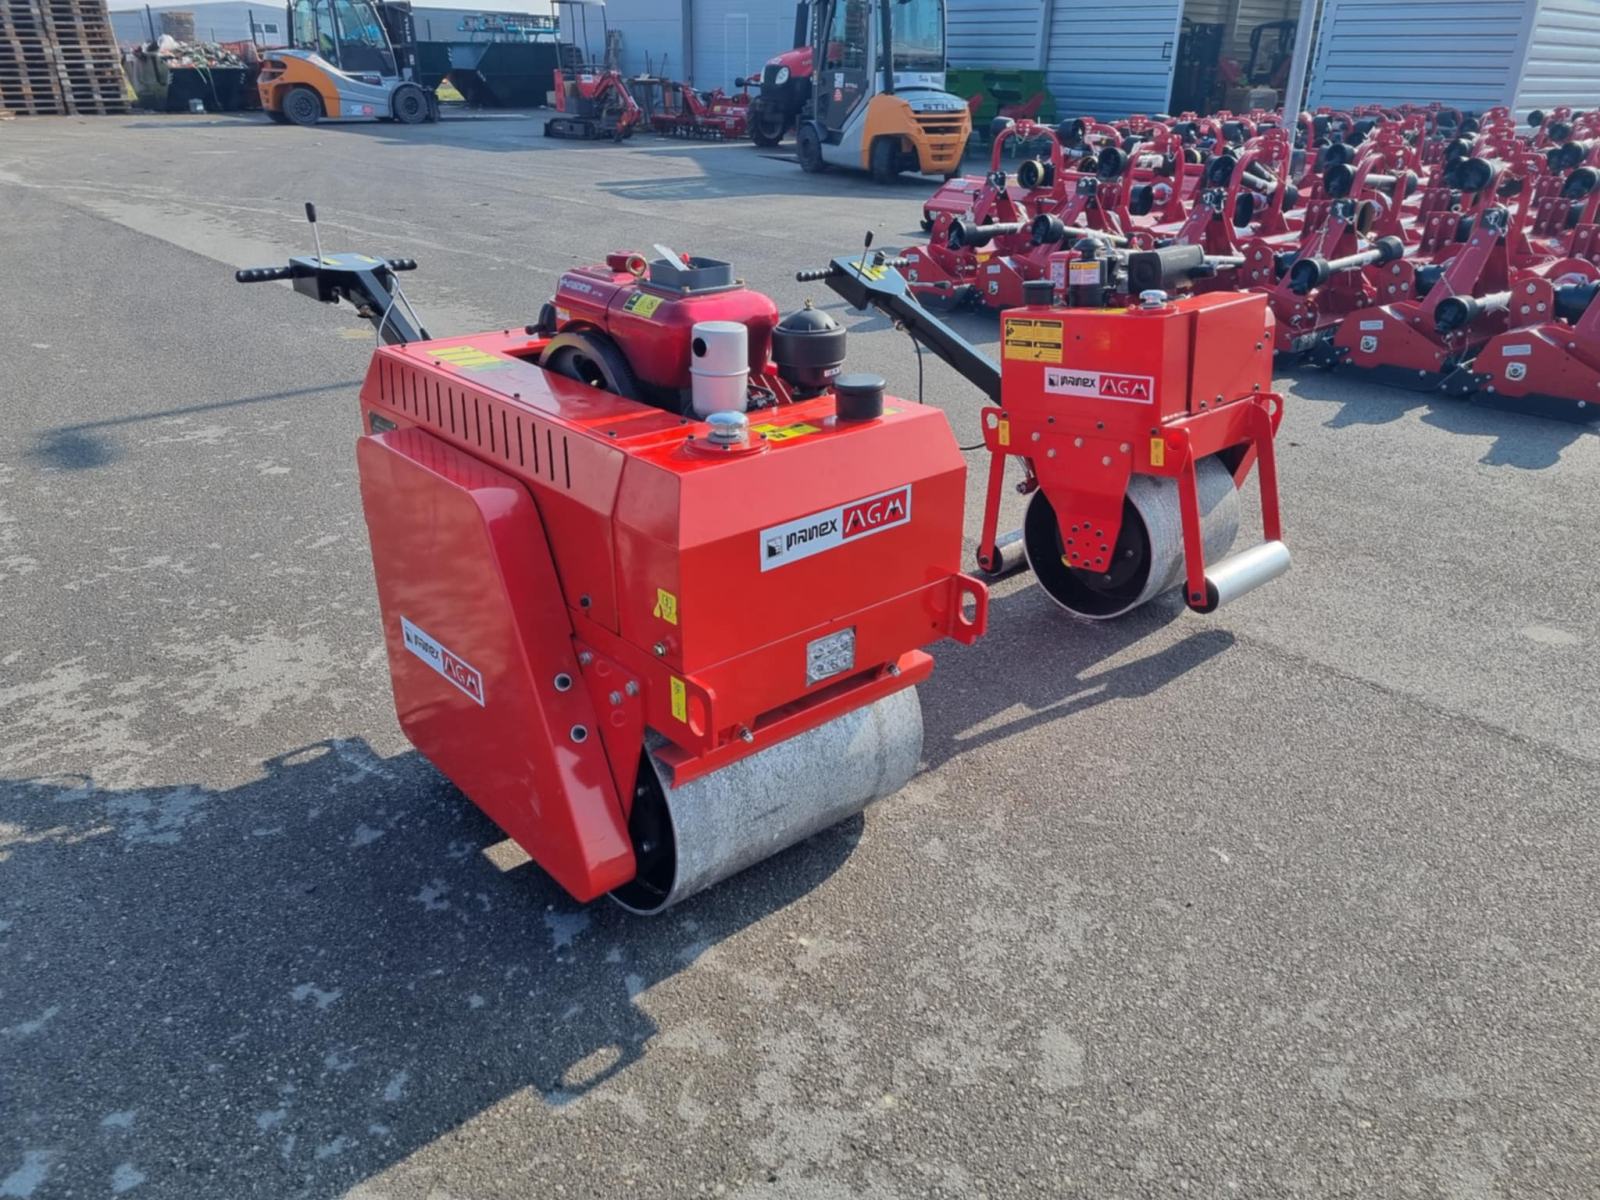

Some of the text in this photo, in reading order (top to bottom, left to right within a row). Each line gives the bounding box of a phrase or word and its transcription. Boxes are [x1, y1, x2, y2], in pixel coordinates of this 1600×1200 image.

[1101, 378, 1148, 397] AGM
[846, 498, 904, 533] AGM
[444, 656, 480, 695] AGM
